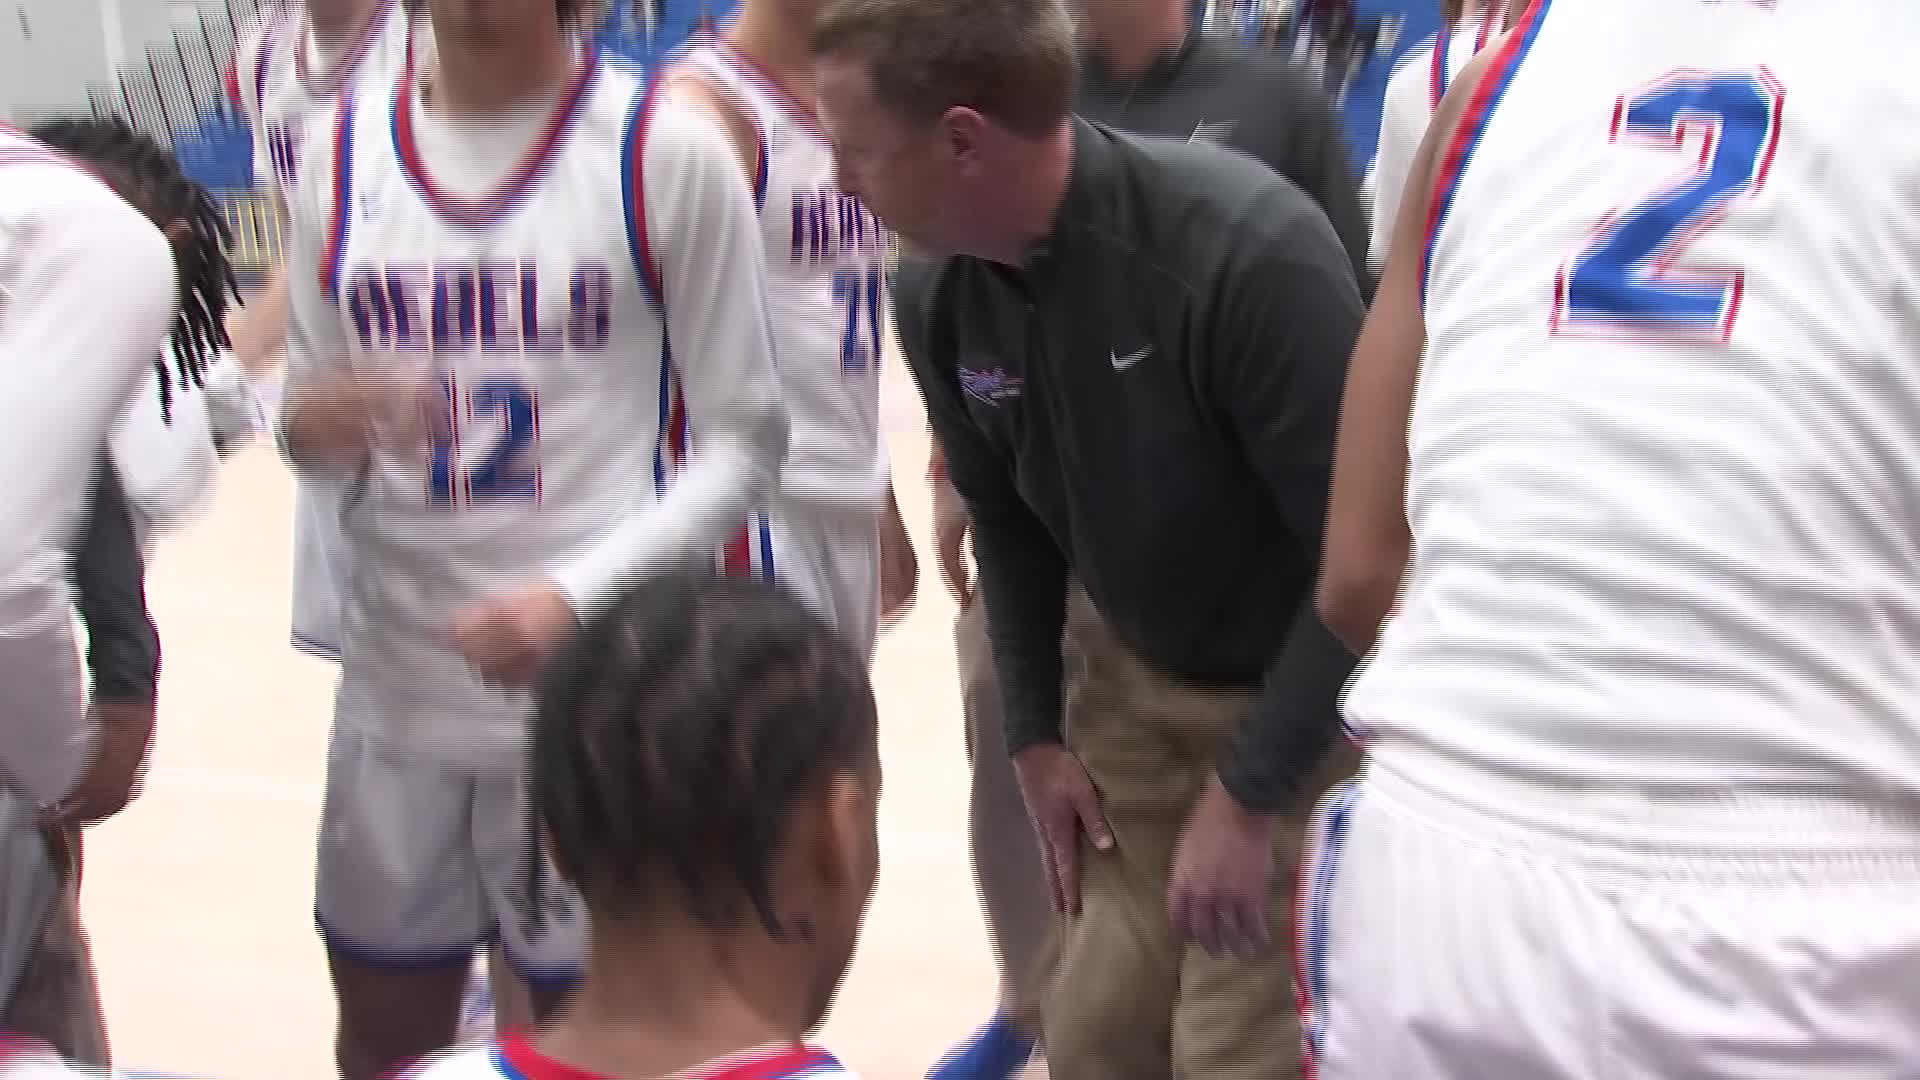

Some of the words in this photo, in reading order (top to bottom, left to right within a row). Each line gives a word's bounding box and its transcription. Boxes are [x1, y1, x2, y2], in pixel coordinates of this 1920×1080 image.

[1548, 64, 1787, 347] 2
[347, 256, 613, 353] REBELS
[425, 370, 543, 510] 12
